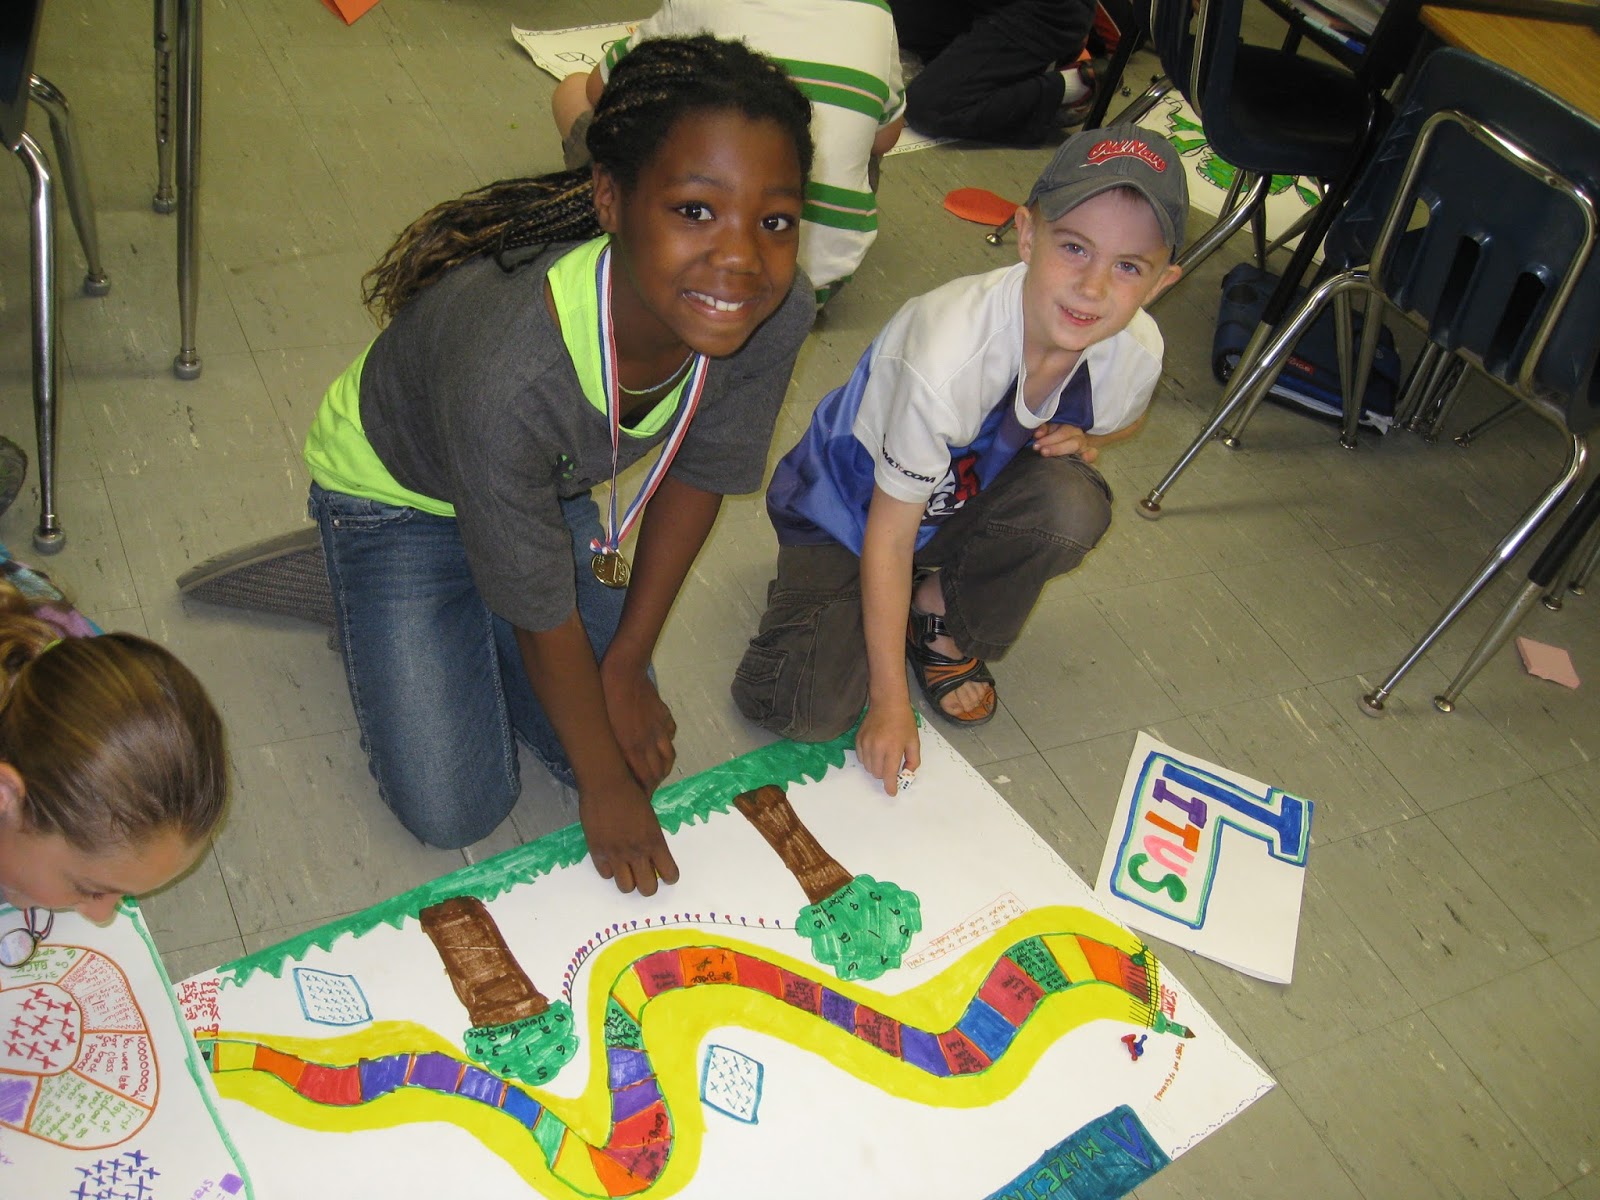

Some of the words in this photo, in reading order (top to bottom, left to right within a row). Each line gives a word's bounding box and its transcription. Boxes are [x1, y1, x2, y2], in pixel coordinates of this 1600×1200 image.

[1087, 139, 1132, 161] Old
[1012, 906, 1025, 918] Try
[193, 1024, 220, 1039] End
[123, 1037, 134, 1049] You
[76, 1043, 98, 1072] spaces
[87, 1051, 105, 1073] back
[118, 1075, 130, 1090] late
[121, 1106, 144, 1130] First
